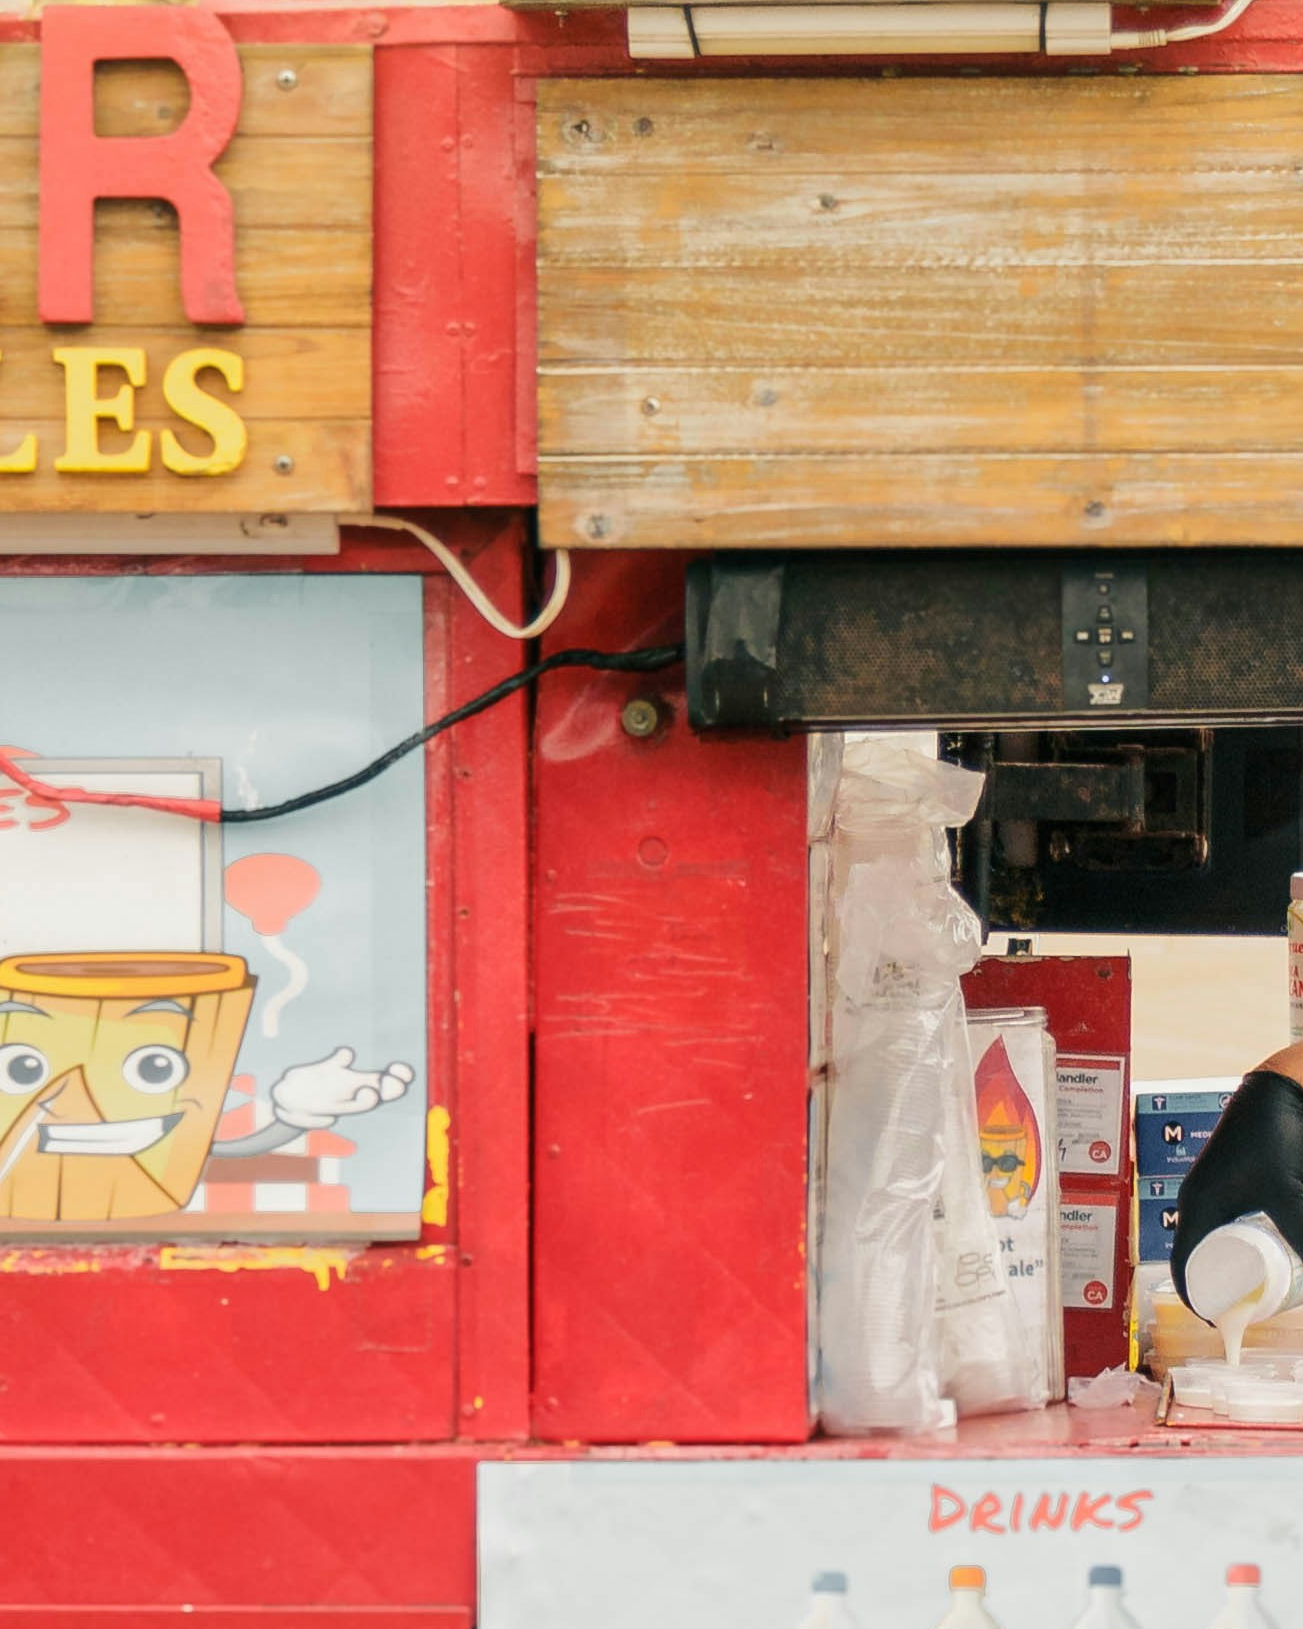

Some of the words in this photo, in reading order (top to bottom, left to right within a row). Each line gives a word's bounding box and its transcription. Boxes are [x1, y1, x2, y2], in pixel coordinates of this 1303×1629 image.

[1056, 1073, 1098, 1084] andler
[1164, 1125, 1182, 1142] M
[1060, 1210, 1093, 1222] ndler
[1162, 1211, 1180, 1227] M
